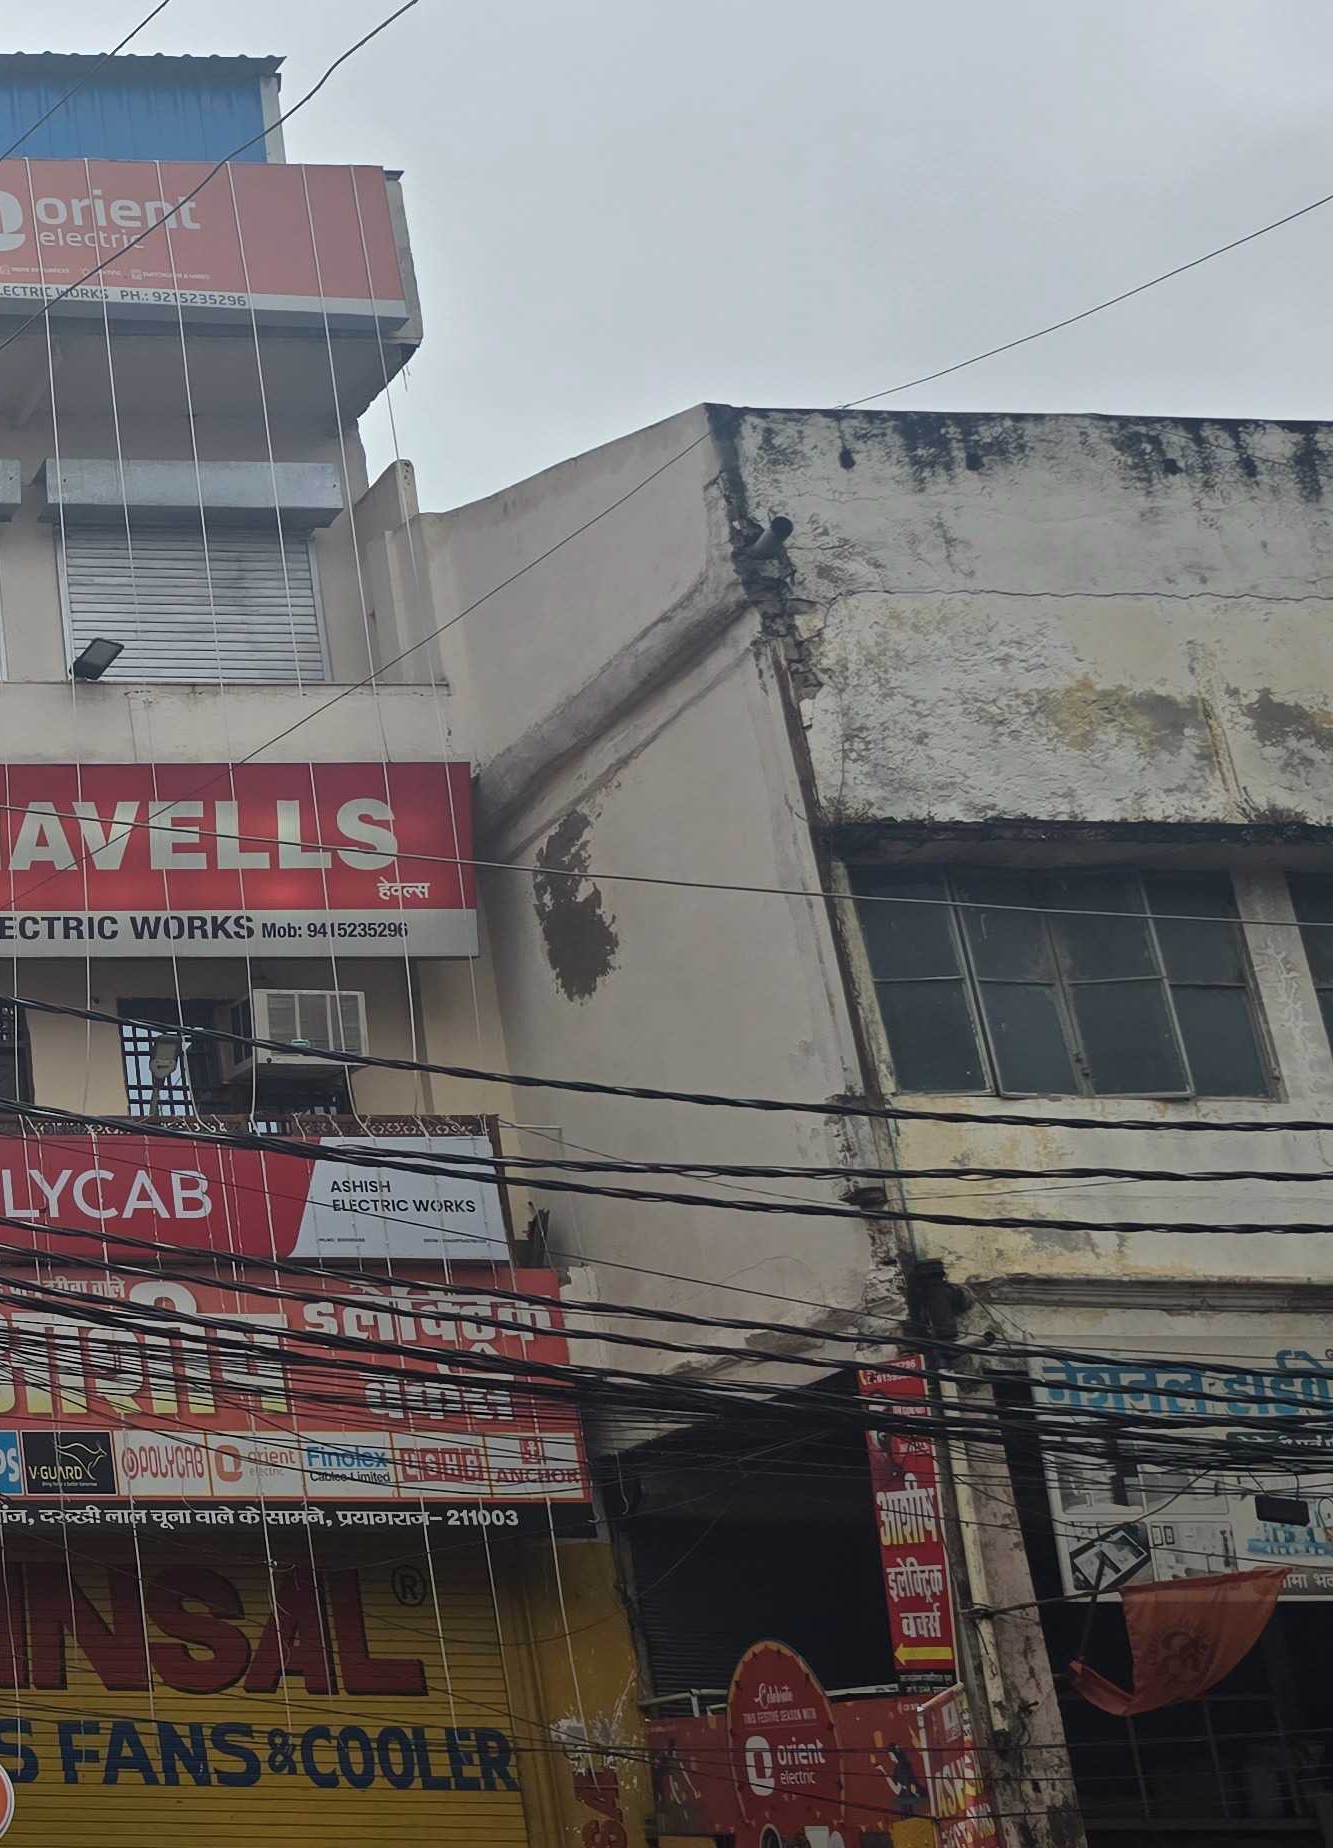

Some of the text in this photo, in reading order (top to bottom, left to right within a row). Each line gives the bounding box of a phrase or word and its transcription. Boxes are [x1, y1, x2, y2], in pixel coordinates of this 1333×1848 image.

[35, 189, 201, 231] orient
[38, 227, 146, 251] electric
[130, 913, 255, 940] WORKS
[261, 921, 303, 940] Mob:
[307, 921, 408, 940] 9415235296
[330, 1179, 392, 1195] ASHISH
[331, 1196, 477, 1215] ELECTRIC WORKS
[140, 1446, 204, 1480] POLYCAB
[247, 1446, 297, 1466] orient
[306, 1446, 388, 1468] Finolex
[104, 1509, 147, 1525] लाल
[149, 1509, 191, 1531] चूना
[195, 1506, 235, 1525] वाले
[237, 1506, 263, 1525] के
[446, 1509, 520, 1527] 211003
[876, 1472, 939, 1547] आशीष
[776, 1736, 827, 1766] orient
